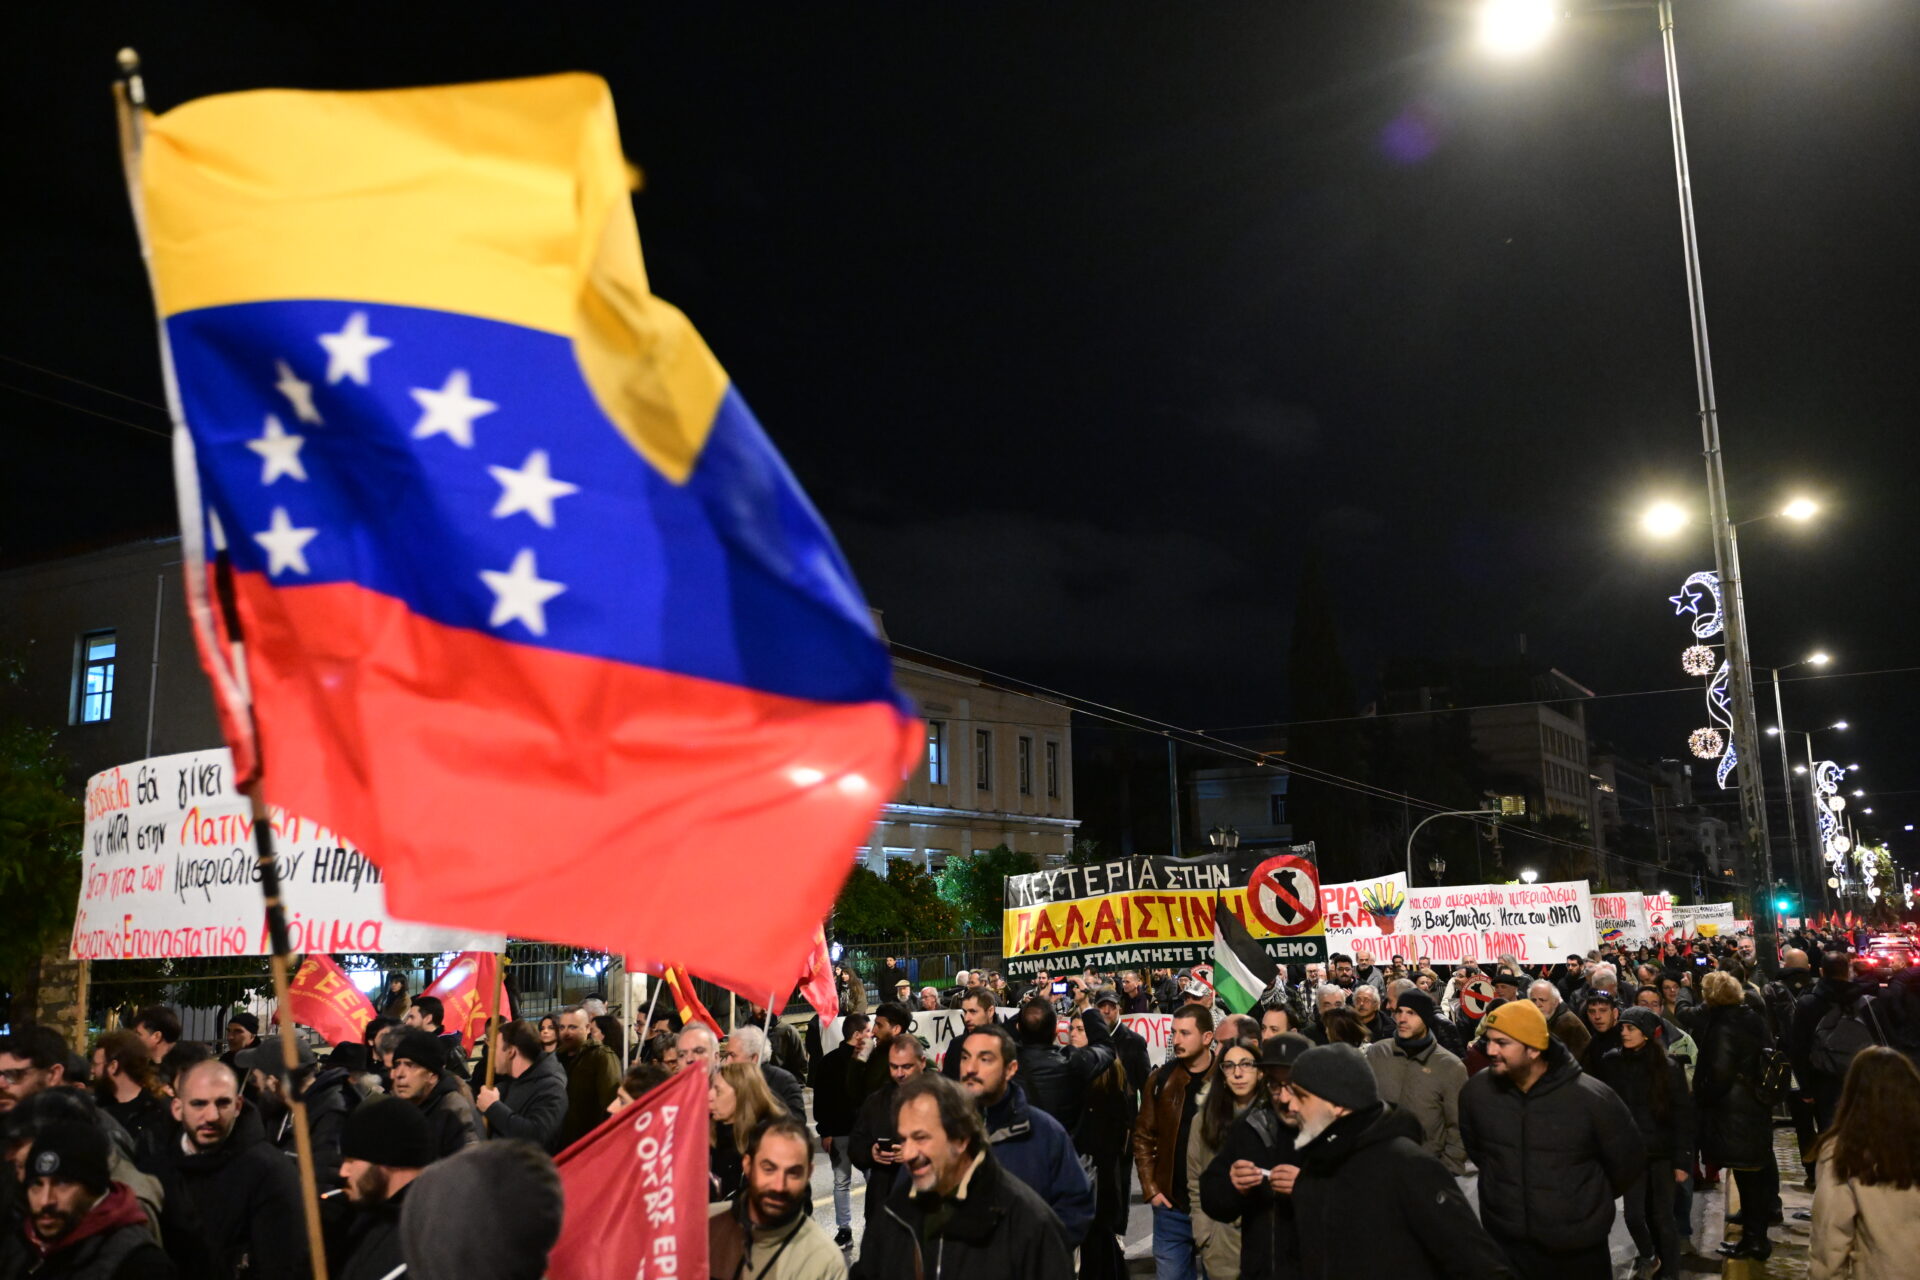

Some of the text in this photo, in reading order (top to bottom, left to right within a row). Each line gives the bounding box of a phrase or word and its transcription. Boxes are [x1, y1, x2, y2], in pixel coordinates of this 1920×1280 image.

[178, 758, 223, 810] γίνει
[107, 813, 130, 856] ΗΠΑ
[137, 823, 167, 854] στην
[1018, 858, 1230, 907] ΛΕΥΤΕΡΙΑ ΣΤΗΝ
[1320, 886, 1363, 914] ΡΙΑ
[1014, 894, 1249, 954] ΠΑΛΑΙΣΤΙΝΗ
[1528, 912, 1546, 924] του
[1549, 904, 1581, 926] ΝΑΤΟ
[1008, 942, 1318, 976] ΣΥΜΜΑΧΙΑ ΣΤΑΜΑΤΗΣΤΕ ΤΟ ΛΕΜΟ
[1485, 932, 1529, 960] ΑΘΗΝΑΣ
